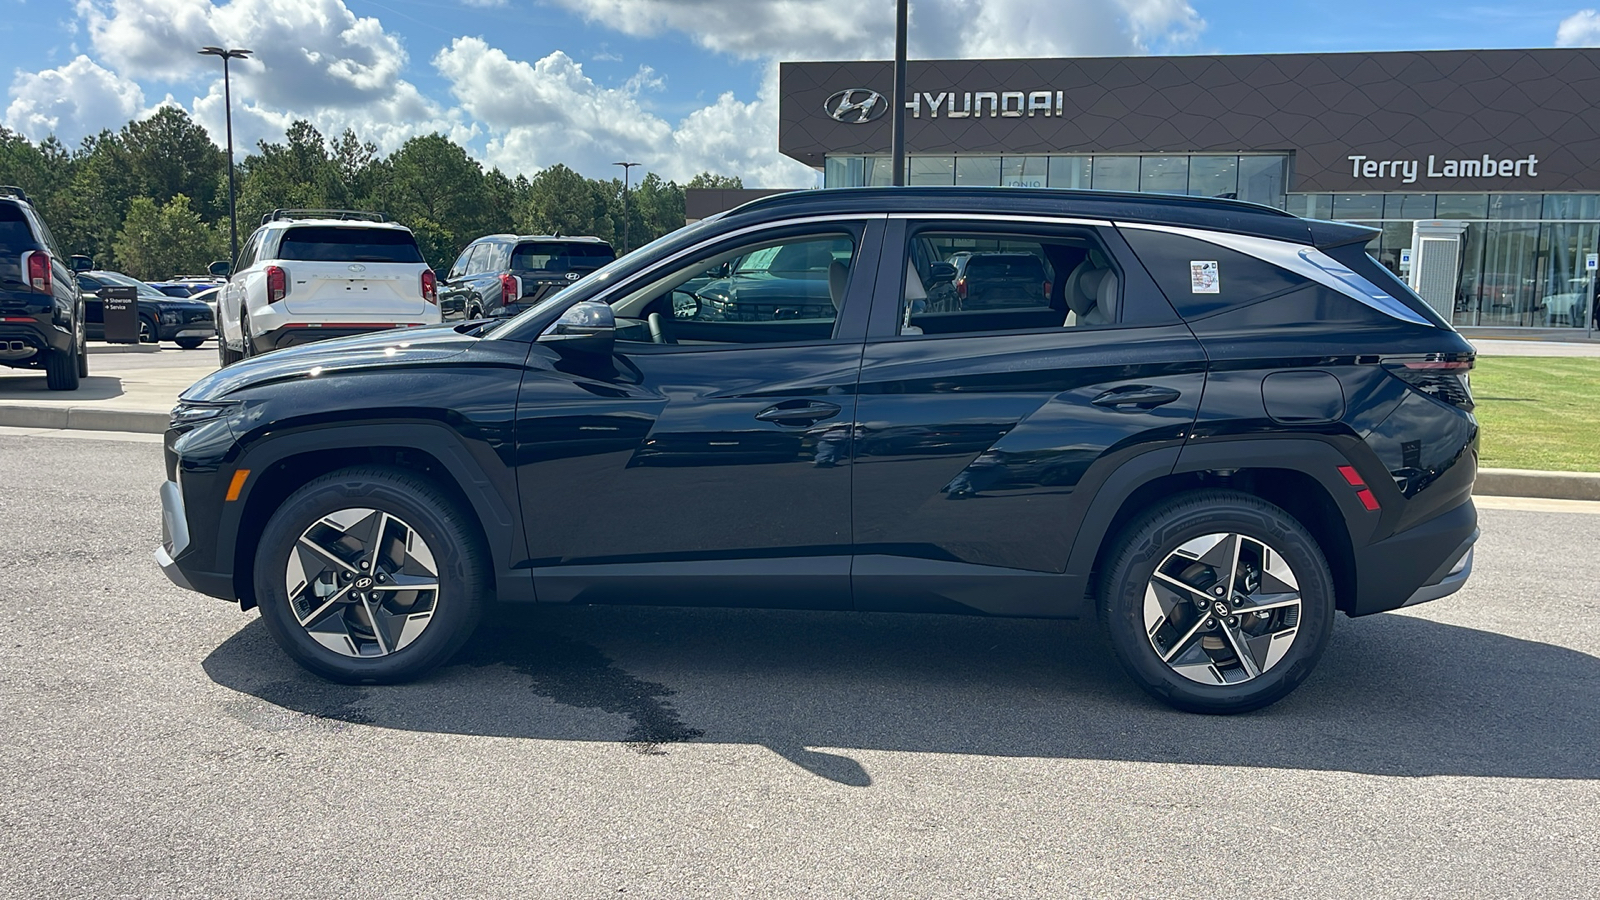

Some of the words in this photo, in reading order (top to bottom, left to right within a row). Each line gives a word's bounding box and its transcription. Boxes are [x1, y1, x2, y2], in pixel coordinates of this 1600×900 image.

[905, 91, 1064, 118] HYUNDAI
[1348, 155, 1418, 183] Terry
[1427, 154, 1539, 178] Lambert
